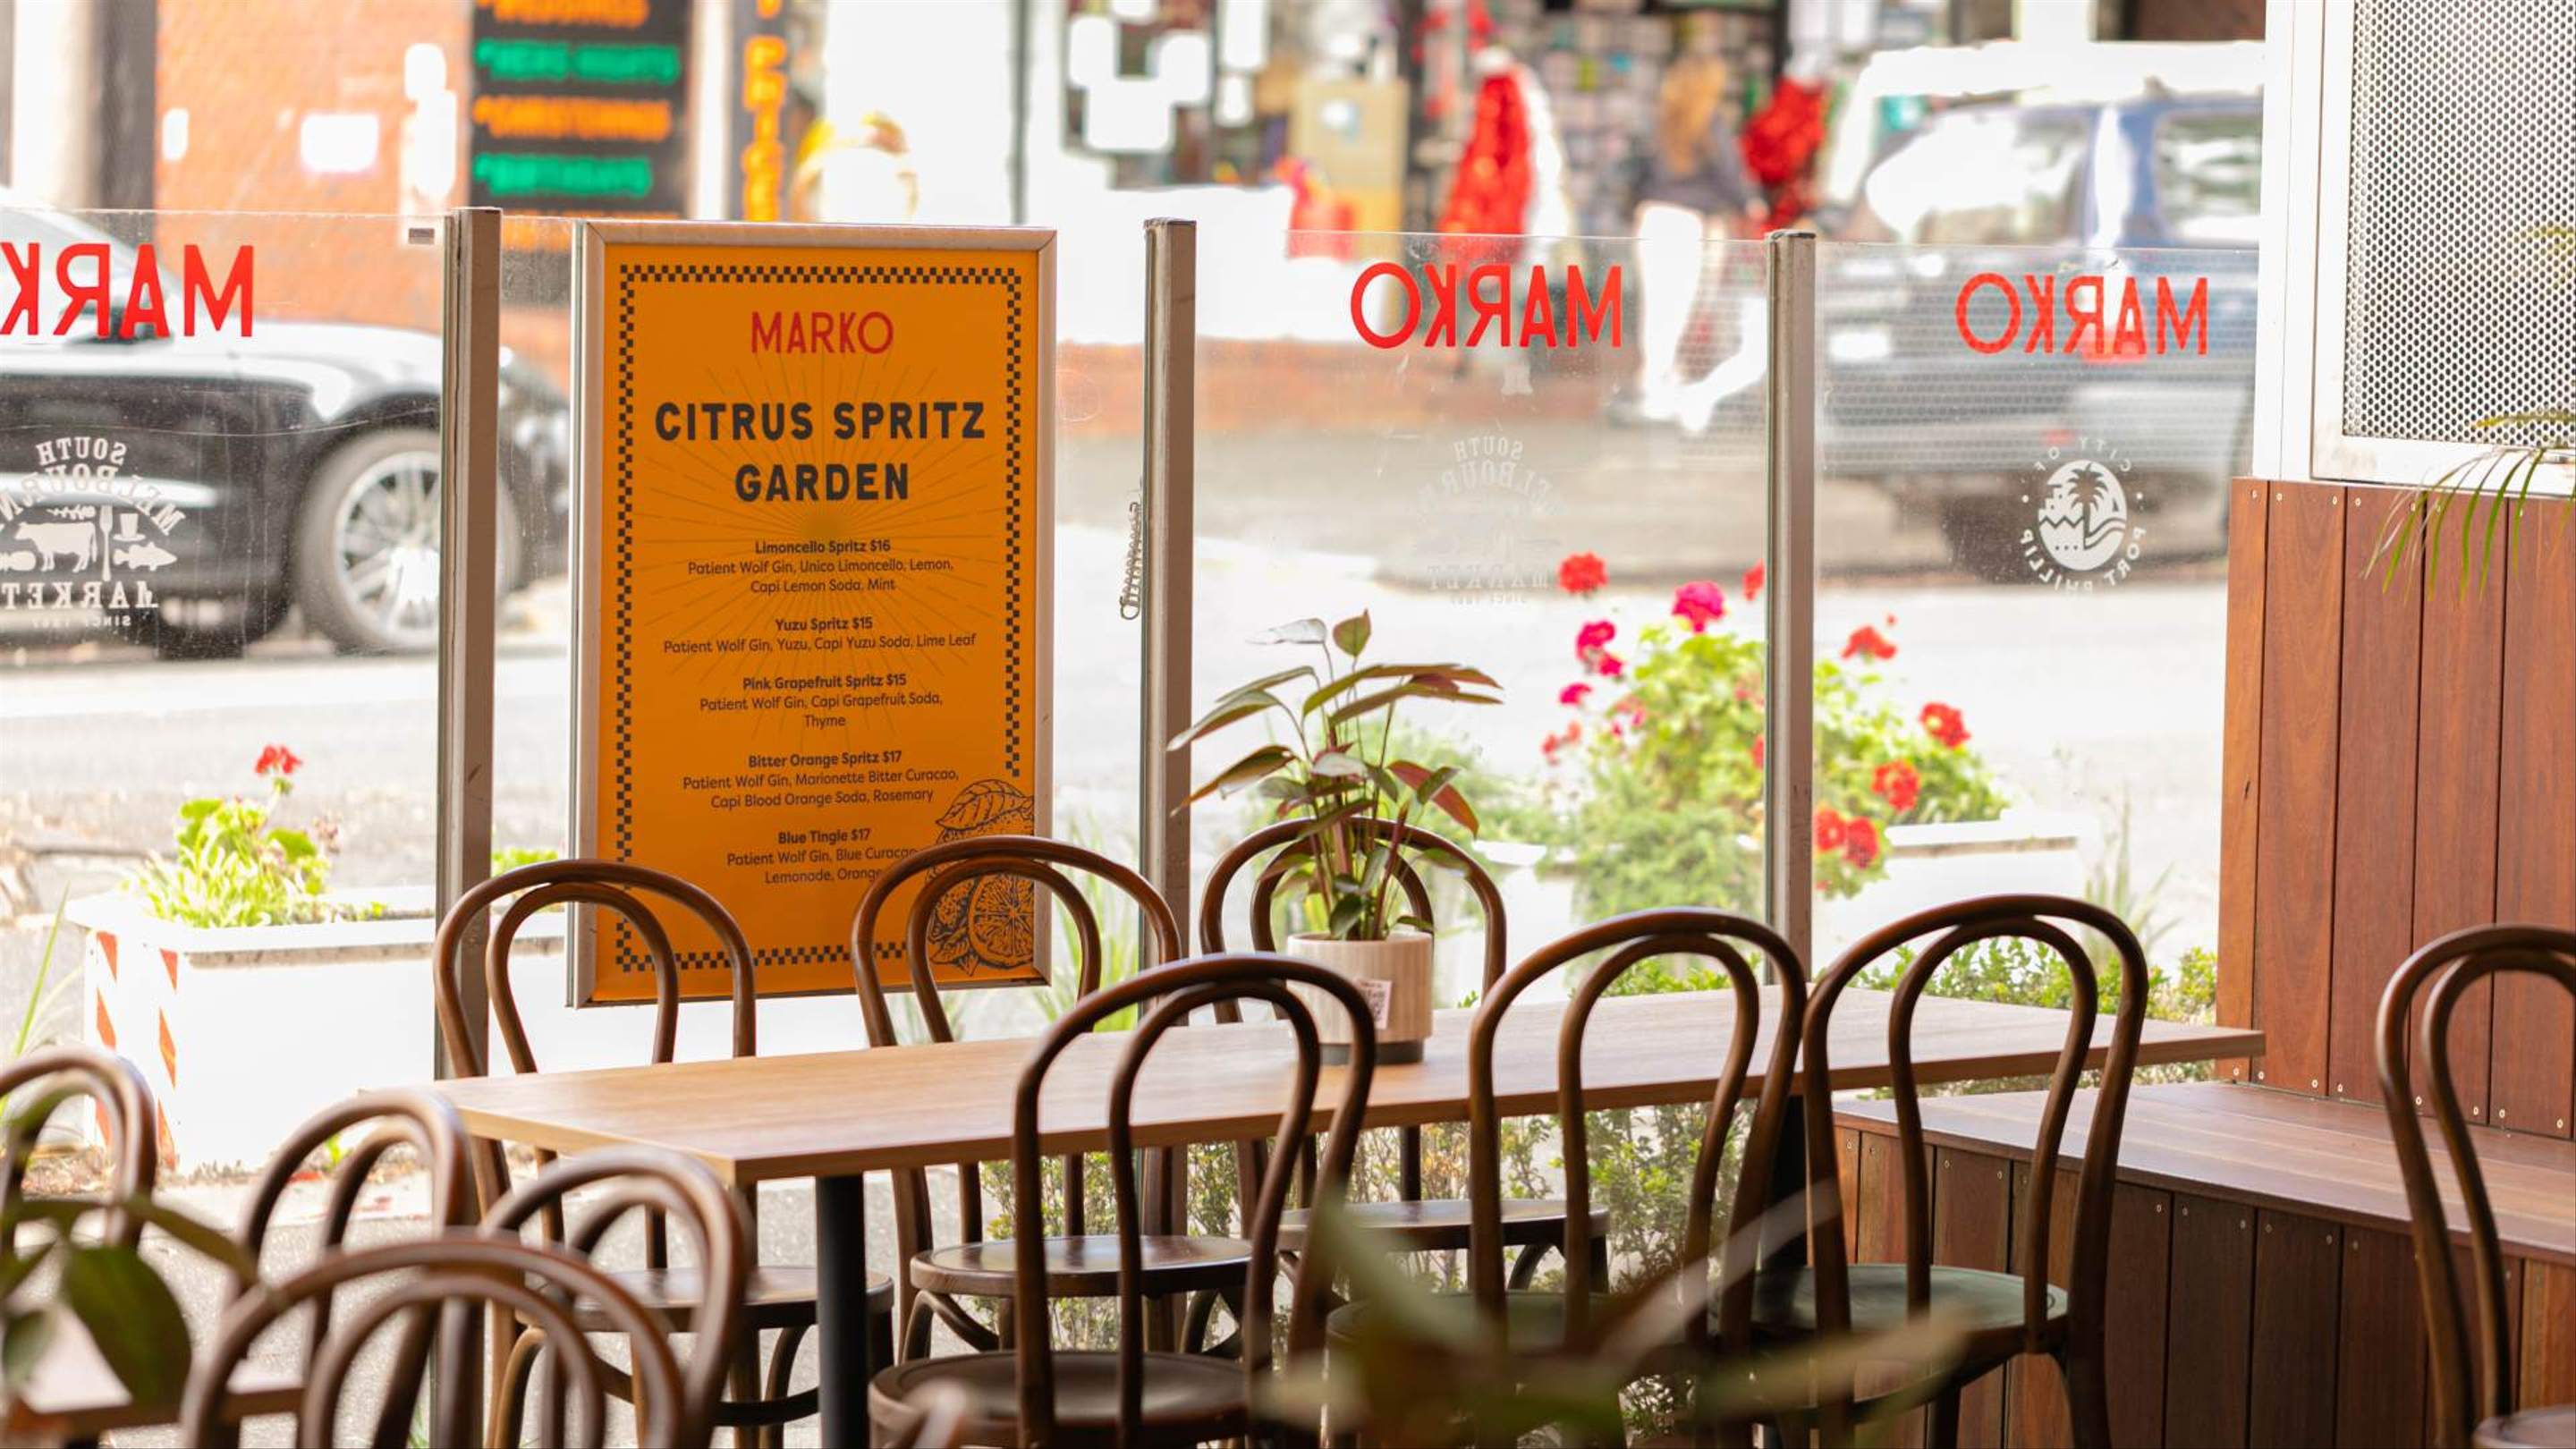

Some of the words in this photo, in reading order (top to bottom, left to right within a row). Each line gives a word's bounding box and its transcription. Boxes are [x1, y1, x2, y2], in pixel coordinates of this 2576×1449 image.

[751, 311, 894, 354] MARKO
[655, 402, 813, 440] CITRUS
[833, 402, 986, 439] SPRITZ
[735, 463, 909, 502] GARDEN
[755, 539, 826, 555] Limoncello
[827, 539, 868, 556] Spritz
[869, 538, 892, 554] $16
[688, 561, 736, 575] Patient
[739, 560, 770, 574] Wolf
[800, 559, 835, 573] Unico
[750, 580, 781, 597] Capi
[783, 580, 826, 593] Lemon
[867, 577, 896, 591] Mint
[775, 618, 809, 631] Yuzu
[809, 616, 850, 634] Spritz
[852, 615, 874, 631] $15
[664, 640, 713, 654] Patient
[716, 638, 747, 654] Wolf
[813, 636, 843, 653] Capi
[846, 636, 877, 649] Yuzu
[915, 634, 945, 648] Lime
[948, 632, 977, 647] Leaf
[742, 676, 772, 691] Pink
[774, 674, 843, 692] Grapefruit
[845, 673, 884, 691] Spritz
[886, 673, 907, 687] $15
[699, 698, 749, 711] Patient
[751, 696, 782, 709] Wolf
[810, 695, 840, 710] Capi
[842, 692, 907, 709] Grapefruit
[804, 714, 847, 731] Thyme
[748, 754, 788, 769] Bitter
[789, 753, 840, 769] Orange
[841, 750, 880, 768] Spritz
[881, 750, 902, 764] $17
[682, 775, 732, 790] Patient
[734, 774, 765, 788] Wolf
[795, 772, 865, 786] Marionette
[868, 769, 902, 784] Bitter
[710, 795, 741, 811] Capi
[743, 793, 782, 808] Blood
[784, 792, 833, 809] Orange
[872, 789, 934, 805] Rosemary
[777, 830, 808, 845] Blue
[808, 828, 849, 846] Tingle
[850, 827, 871, 842] $17
[726, 852, 775, 867] Patient
[777, 849, 807, 864] Wolf
[835, 848, 863, 861] Blue
